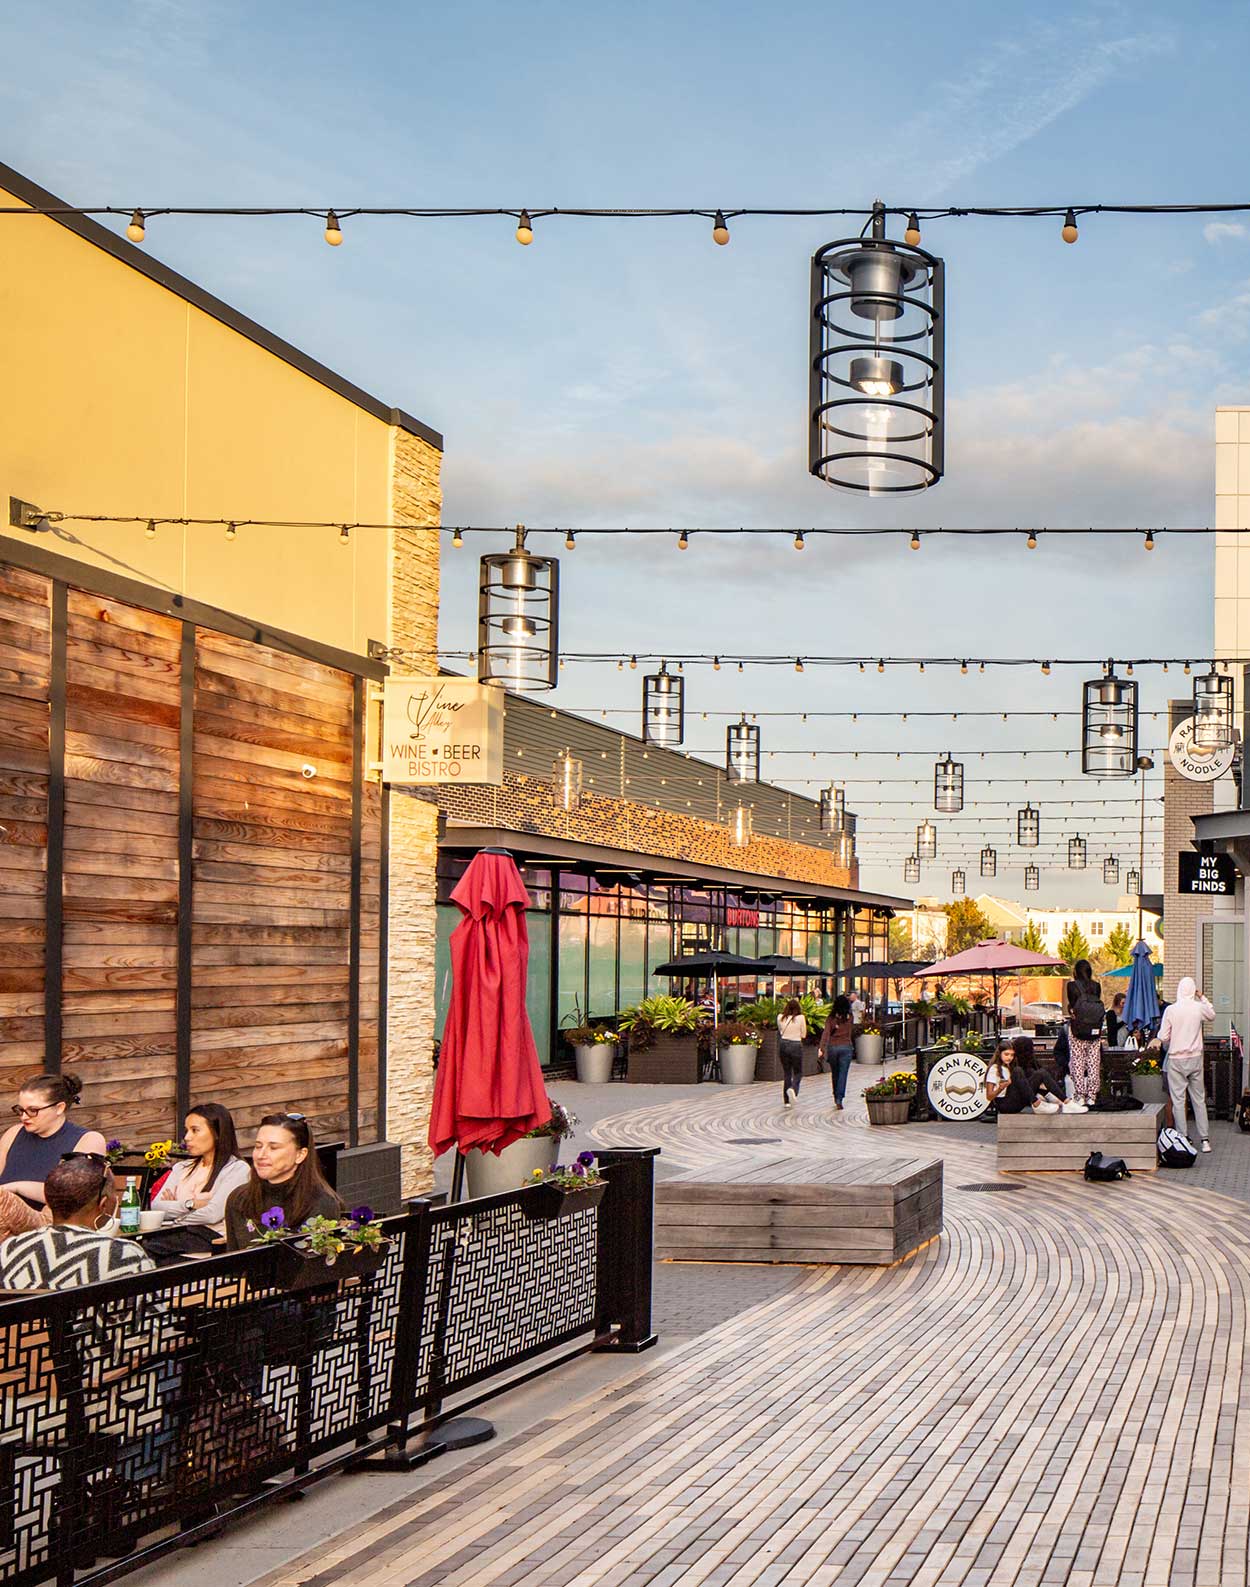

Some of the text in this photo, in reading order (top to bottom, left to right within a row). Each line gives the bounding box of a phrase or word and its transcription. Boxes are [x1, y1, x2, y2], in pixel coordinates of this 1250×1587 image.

[411, 683, 465, 726] Vine
[390, 744, 480, 760] WINE BEER
[408, 762, 461, 776] BISTRO
[1180, 759, 1222, 774] NOODLE
[1201, 857, 1217, 867] MY
[1199, 869, 1219, 879] BIG
[1191, 880, 1226, 892] FINDS
[937, 1058, 986, 1077] RAN KEN
[938, 1098, 983, 1115] NOODLE
